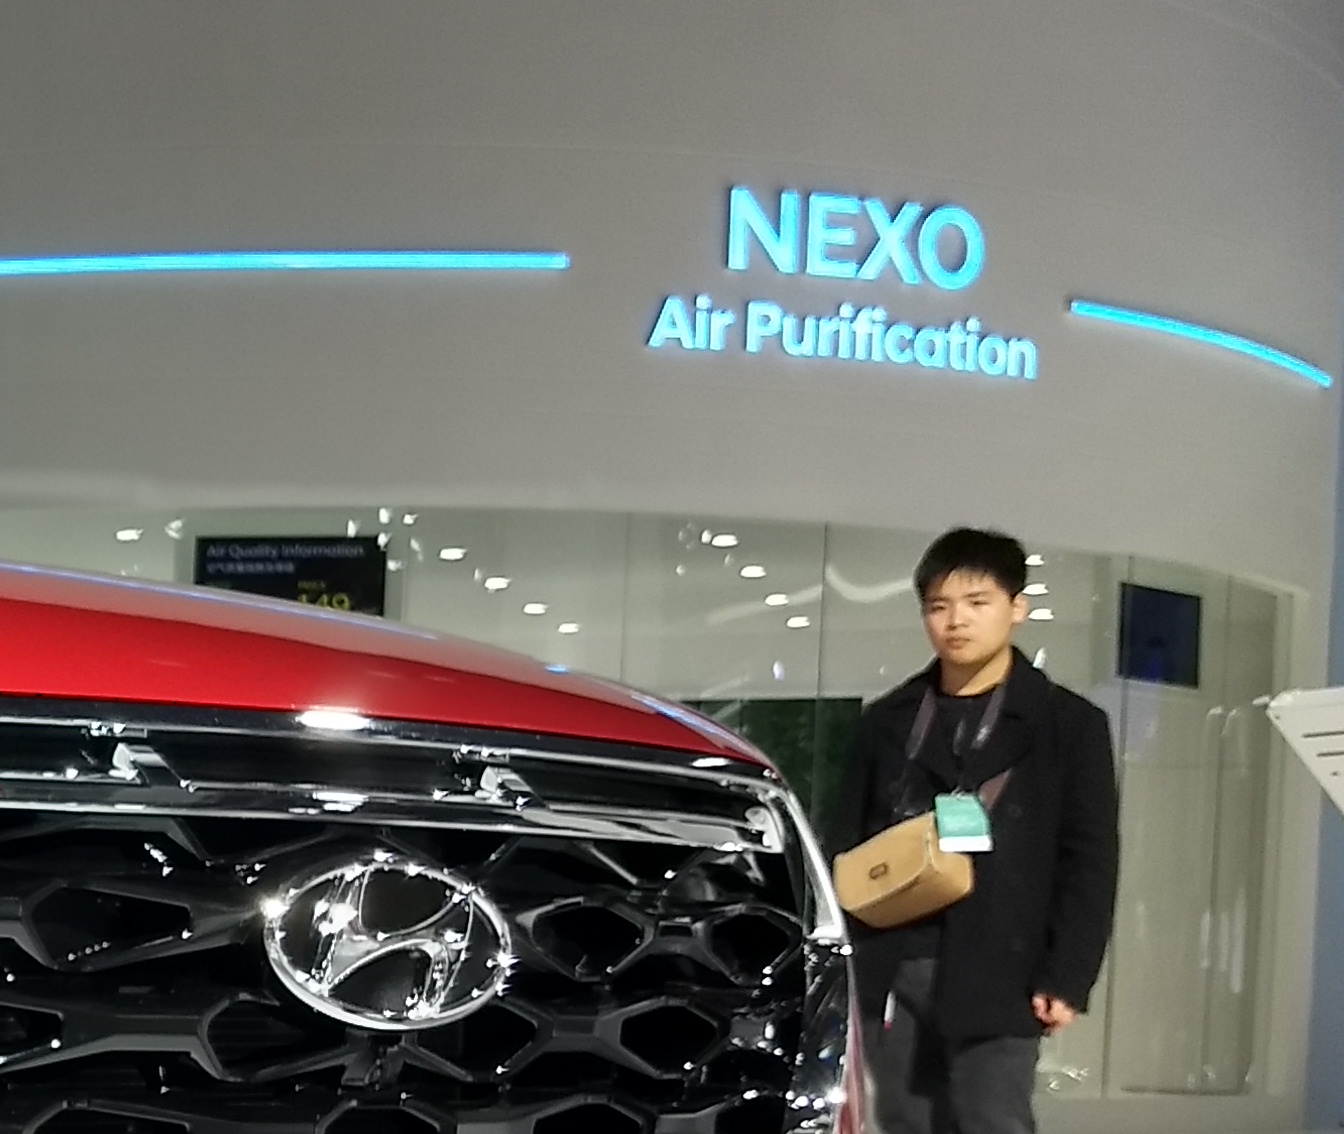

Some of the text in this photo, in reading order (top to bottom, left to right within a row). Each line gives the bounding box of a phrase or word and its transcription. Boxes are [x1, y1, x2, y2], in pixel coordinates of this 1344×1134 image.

[727, 185, 986, 291] NEXO
[647, 294, 1037, 380] Air Purification
[206, 544, 364, 559] Air Quality Information
